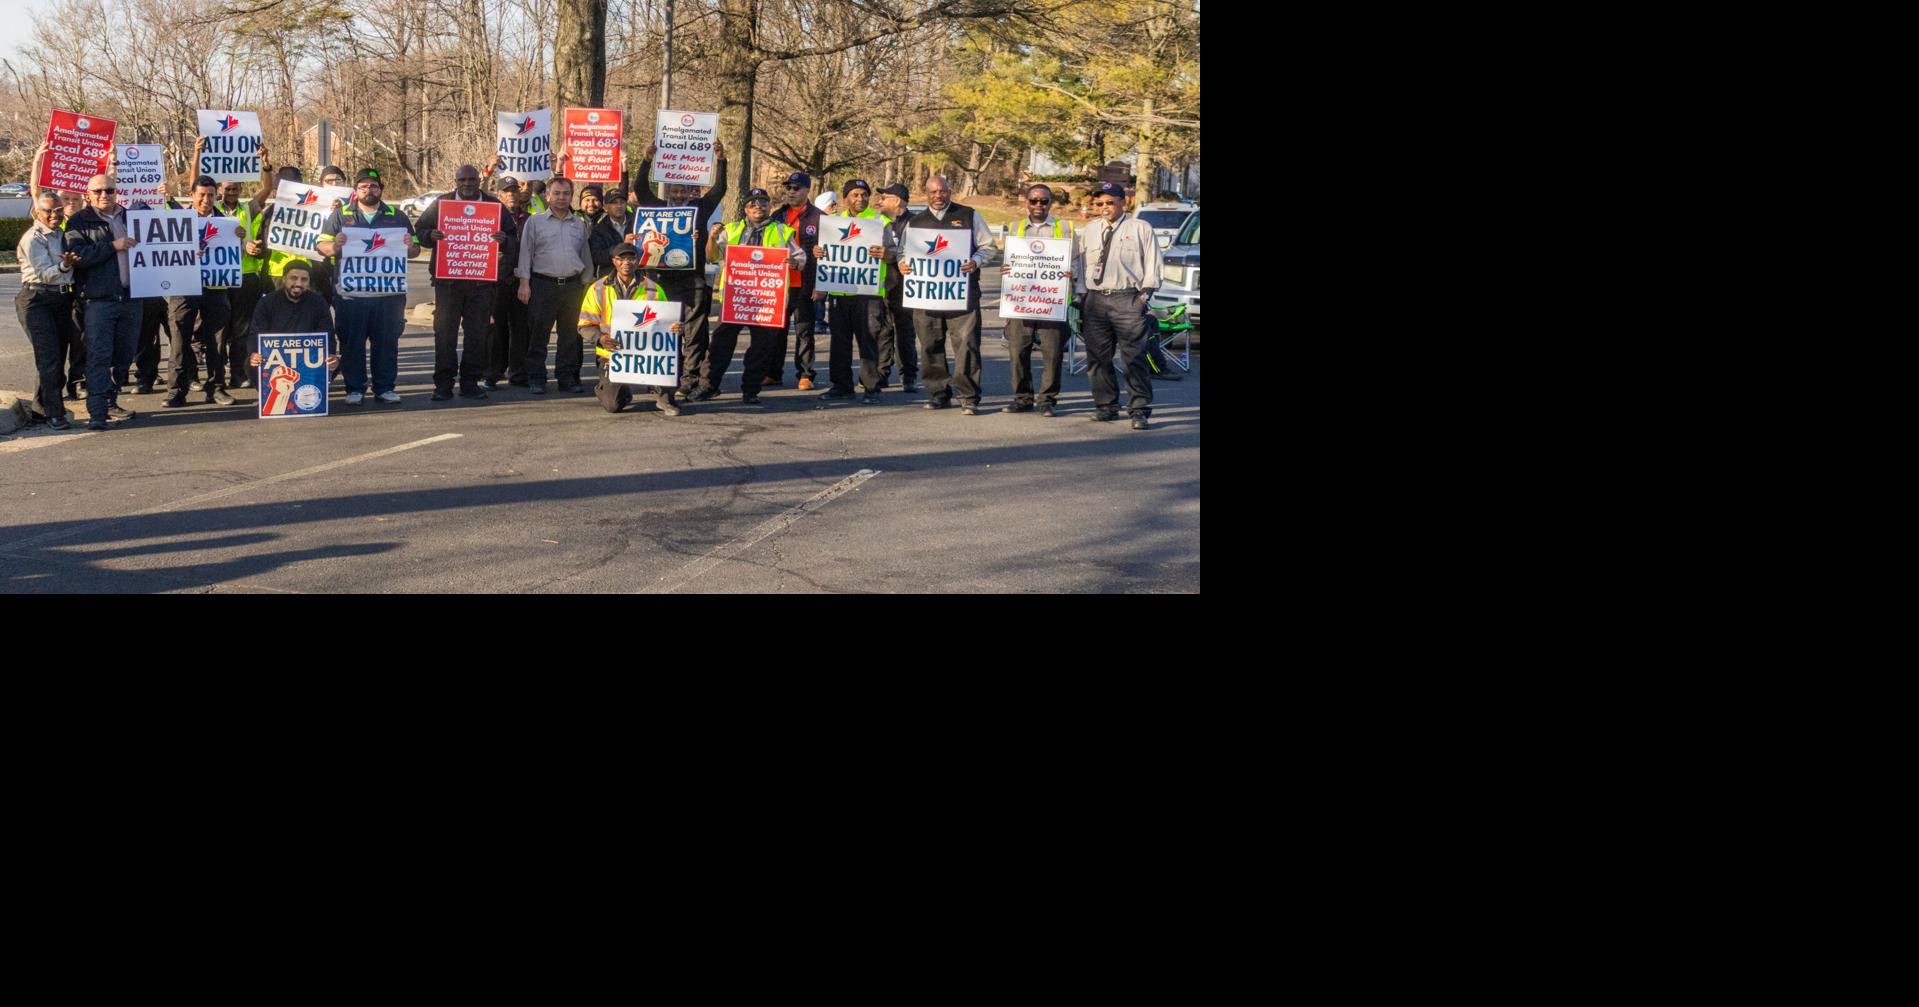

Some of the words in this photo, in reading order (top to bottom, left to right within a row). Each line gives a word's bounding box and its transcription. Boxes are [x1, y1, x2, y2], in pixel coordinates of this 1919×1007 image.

[54, 125, 108, 141] Amalgamated
[569, 123, 618, 131] Amalgamated
[661, 125, 711, 134] Amalgamated
[54, 133, 80, 144] Transit
[82, 138, 104, 148] Union
[201, 135, 233, 153] ATU
[499, 137, 528, 154] ATU
[532, 134, 550, 152] ON
[568, 138, 594, 147] Local
[597, 138, 618, 148] 689
[659, 140, 687, 150] Local
[690, 142, 711, 151] 689
[49, 141, 79, 154] Local
[83, 147, 107, 159] 689
[574, 148, 612, 156] TOGETHER
[54, 153, 98, 166] TOGETHER
[498, 154, 550, 172] STRIKE
[680, 154, 706, 162] MOVE
[51, 161, 67, 169] WE
[201, 156, 260, 174] STRIKE
[679, 164, 710, 172] WHOLE
[51, 169, 90, 182] TOGETHE
[116, 174, 137, 183] ocal
[140, 174, 161, 183] 689
[665, 173, 700, 181] REGION!
[274, 207, 307, 227] ATU
[443, 216, 495, 225] Amalgamated
[133, 219, 140, 243] I
[146, 218, 192, 242] AM
[638, 217, 692, 234] ATU
[270, 226, 320, 251] STRIK
[447, 243, 488, 251] TOGETHER
[820, 244, 853, 263] ATU
[133, 252, 146, 268] A
[152, 250, 195, 266] MAN
[214, 246, 240, 265] ON
[1010, 253, 1064, 261] Amalgamated
[343, 256, 377, 273] ATU
[381, 257, 406, 273] ON
[447, 259, 488, 267] TOGETHER
[730, 260, 783, 270] Amalgamated
[909, 257, 938, 277] ATU
[201, 269, 240, 287] RIKE
[731, 268, 756, 276] Transit
[818, 264, 878, 286] STRIKE
[1040, 271, 1064, 280] 689
[343, 276, 406, 293] STRIKE
[728, 276, 757, 287] Local
[760, 279, 783, 288] 689
[734, 288, 775, 297] TOGETHER
[905, 279, 966, 299] STRIKE
[1030, 285, 1059, 293] MOVE
[1005, 294, 1026, 302] THIS
[1029, 296, 1064, 305] WHOLE
[733, 304, 775, 314] TOGETHER
[1013, 305, 1052, 315] REGION!
[263, 340, 280, 348] WE
[303, 339, 323, 347] ONE
[615, 330, 648, 351] ATU
[652, 332, 676, 352] ON
[264, 348, 324, 369] ATU
[611, 353, 675, 376] STRIKE
